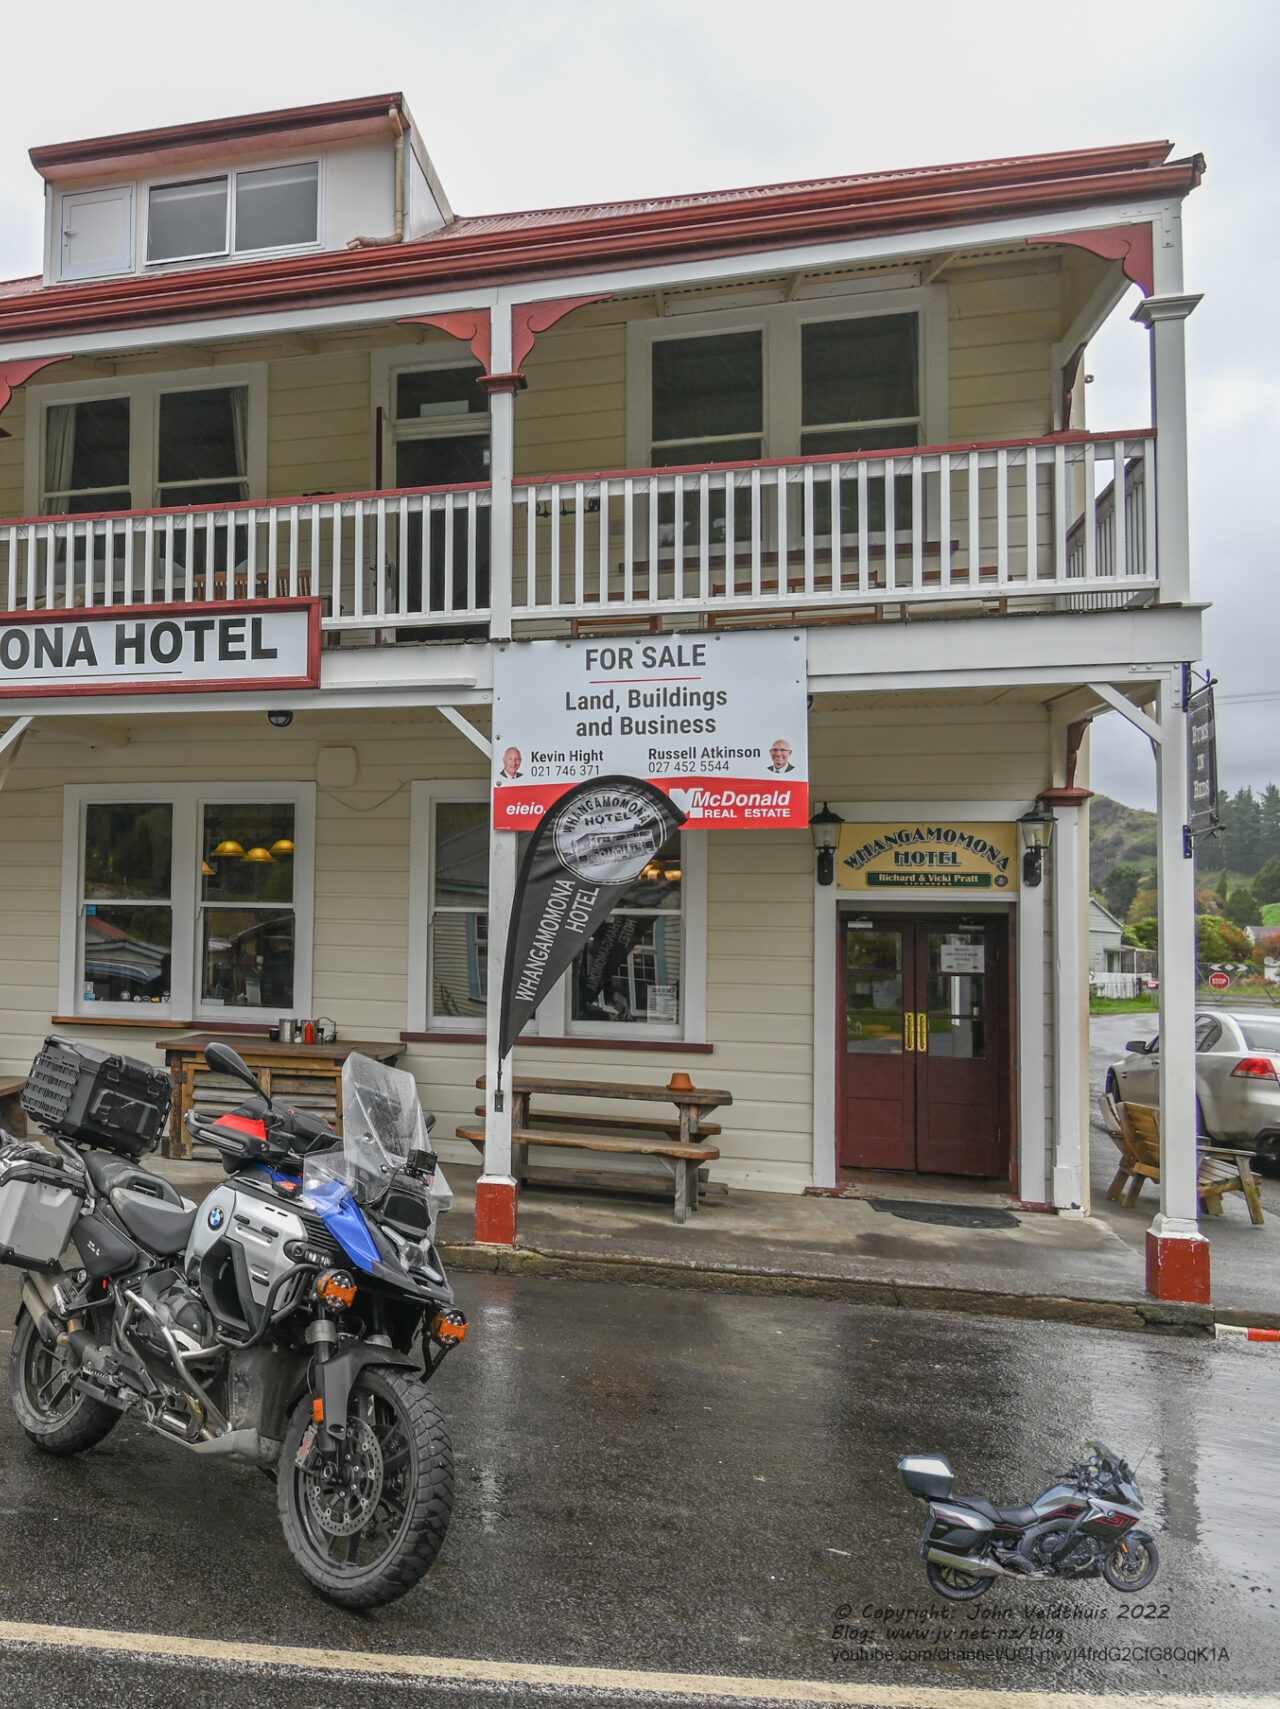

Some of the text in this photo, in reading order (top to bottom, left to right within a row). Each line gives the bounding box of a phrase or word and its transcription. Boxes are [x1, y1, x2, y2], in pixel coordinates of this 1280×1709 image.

[114, 617, 279, 666] HOTEL
[585, 643, 706, 672] FOR SALE
[565, 687, 728, 713] Land, Buildings
[576, 716, 717, 737] and Business
[531, 749, 604, 765] Kevin Hight
[648, 747, 761, 760] Russell Atkinson
[531, 764, 600, 777] 021 746 371
[648, 760, 730, 773] 027 452 5544
[692, 790, 791, 808] McDonald
[563, 795, 651, 833] WHANGAMOMONA
[584, 812, 631, 826] HOTEL
[704, 808, 791, 819] REAL ESTATE
[843, 827, 1010, 872] WHANGAMOMONA
[894, 851, 962, 867] HOTEL
[879, 873, 978, 883] Richard & Vicki Pratt
[565, 887, 600, 933] HOTEL
[515, 879, 576, 1001] WHANGAMOMONA
